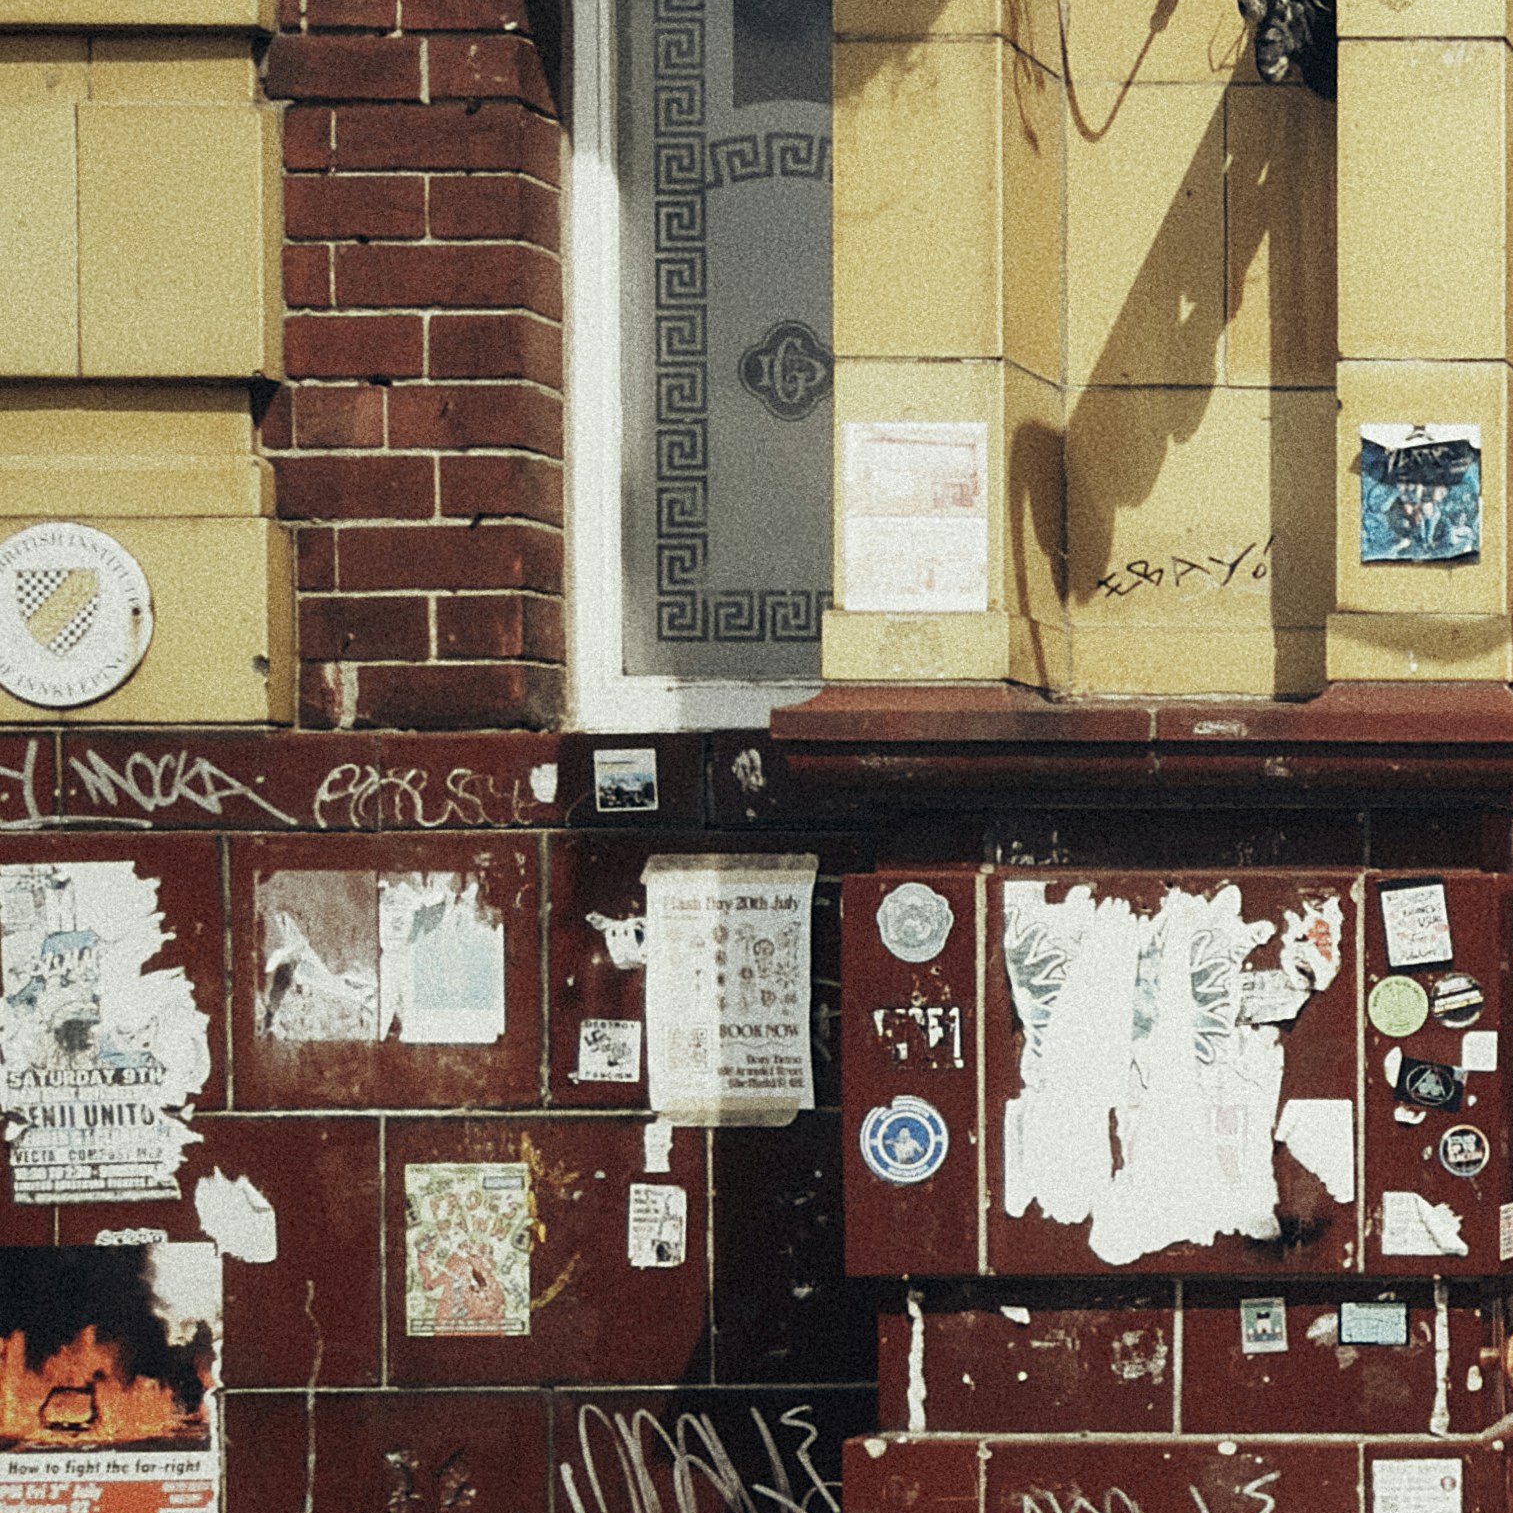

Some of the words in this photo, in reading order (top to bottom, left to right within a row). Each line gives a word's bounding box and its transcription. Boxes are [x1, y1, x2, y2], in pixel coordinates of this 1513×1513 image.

[771, 894, 801, 913] July
[719, 1024, 763, 1039] BOOK
[766, 1024, 799, 1039] NOW
[8, 1068, 115, 1089] SATURDAY
[8, 1460, 40, 1475] How
[46, 1461, 60, 1475] to
[65, 1460, 100, 1478] fight
[106, 1460, 129, 1474] the
[135, 1459, 201, 1476] far-right
